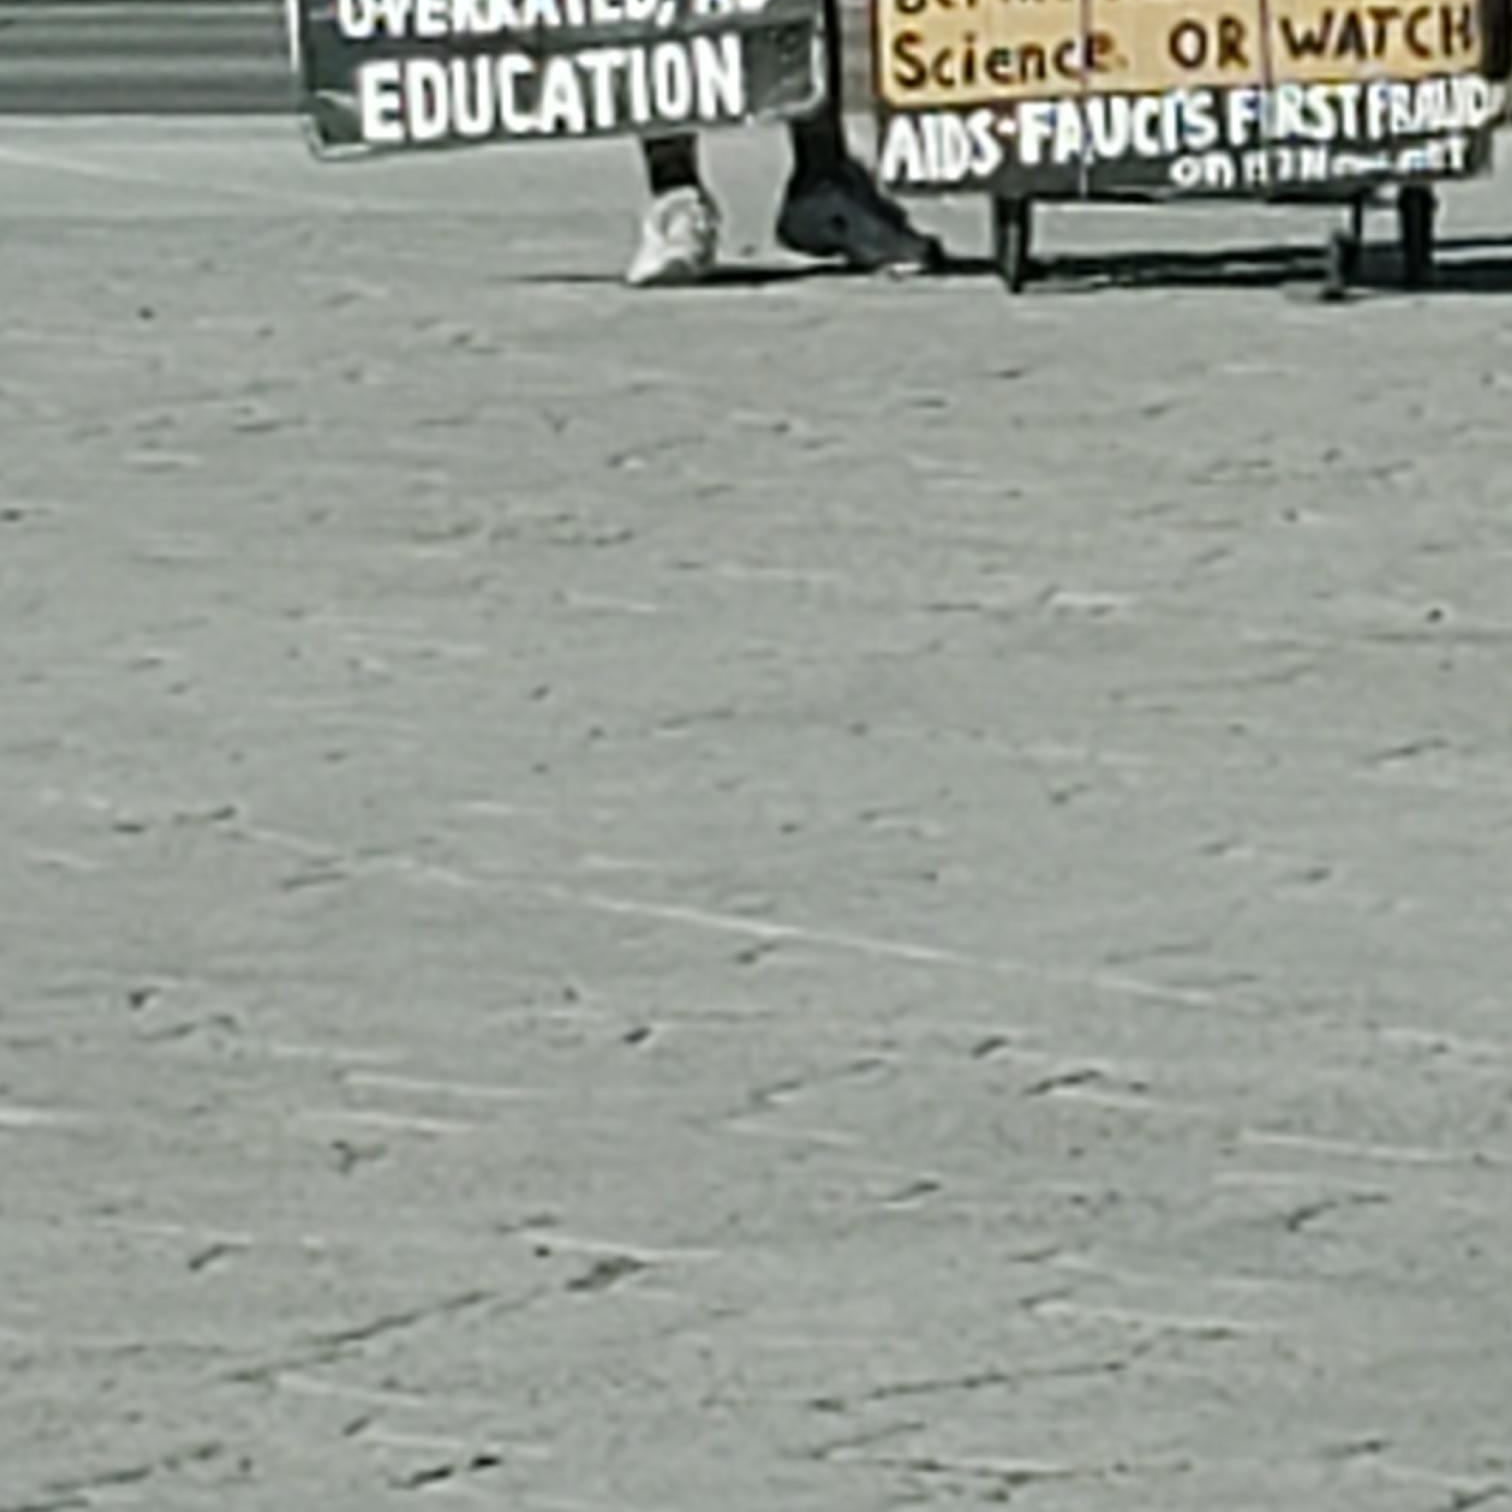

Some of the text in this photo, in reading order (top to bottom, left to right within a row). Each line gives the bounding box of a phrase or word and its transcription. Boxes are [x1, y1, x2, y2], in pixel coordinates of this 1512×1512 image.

[1169, 15, 1249, 69] OR
[1280, 3, 1473, 64] WATCH
[359, 34, 743, 143] EDUCATION
[1229, 82, 1362, 146] FIRST
